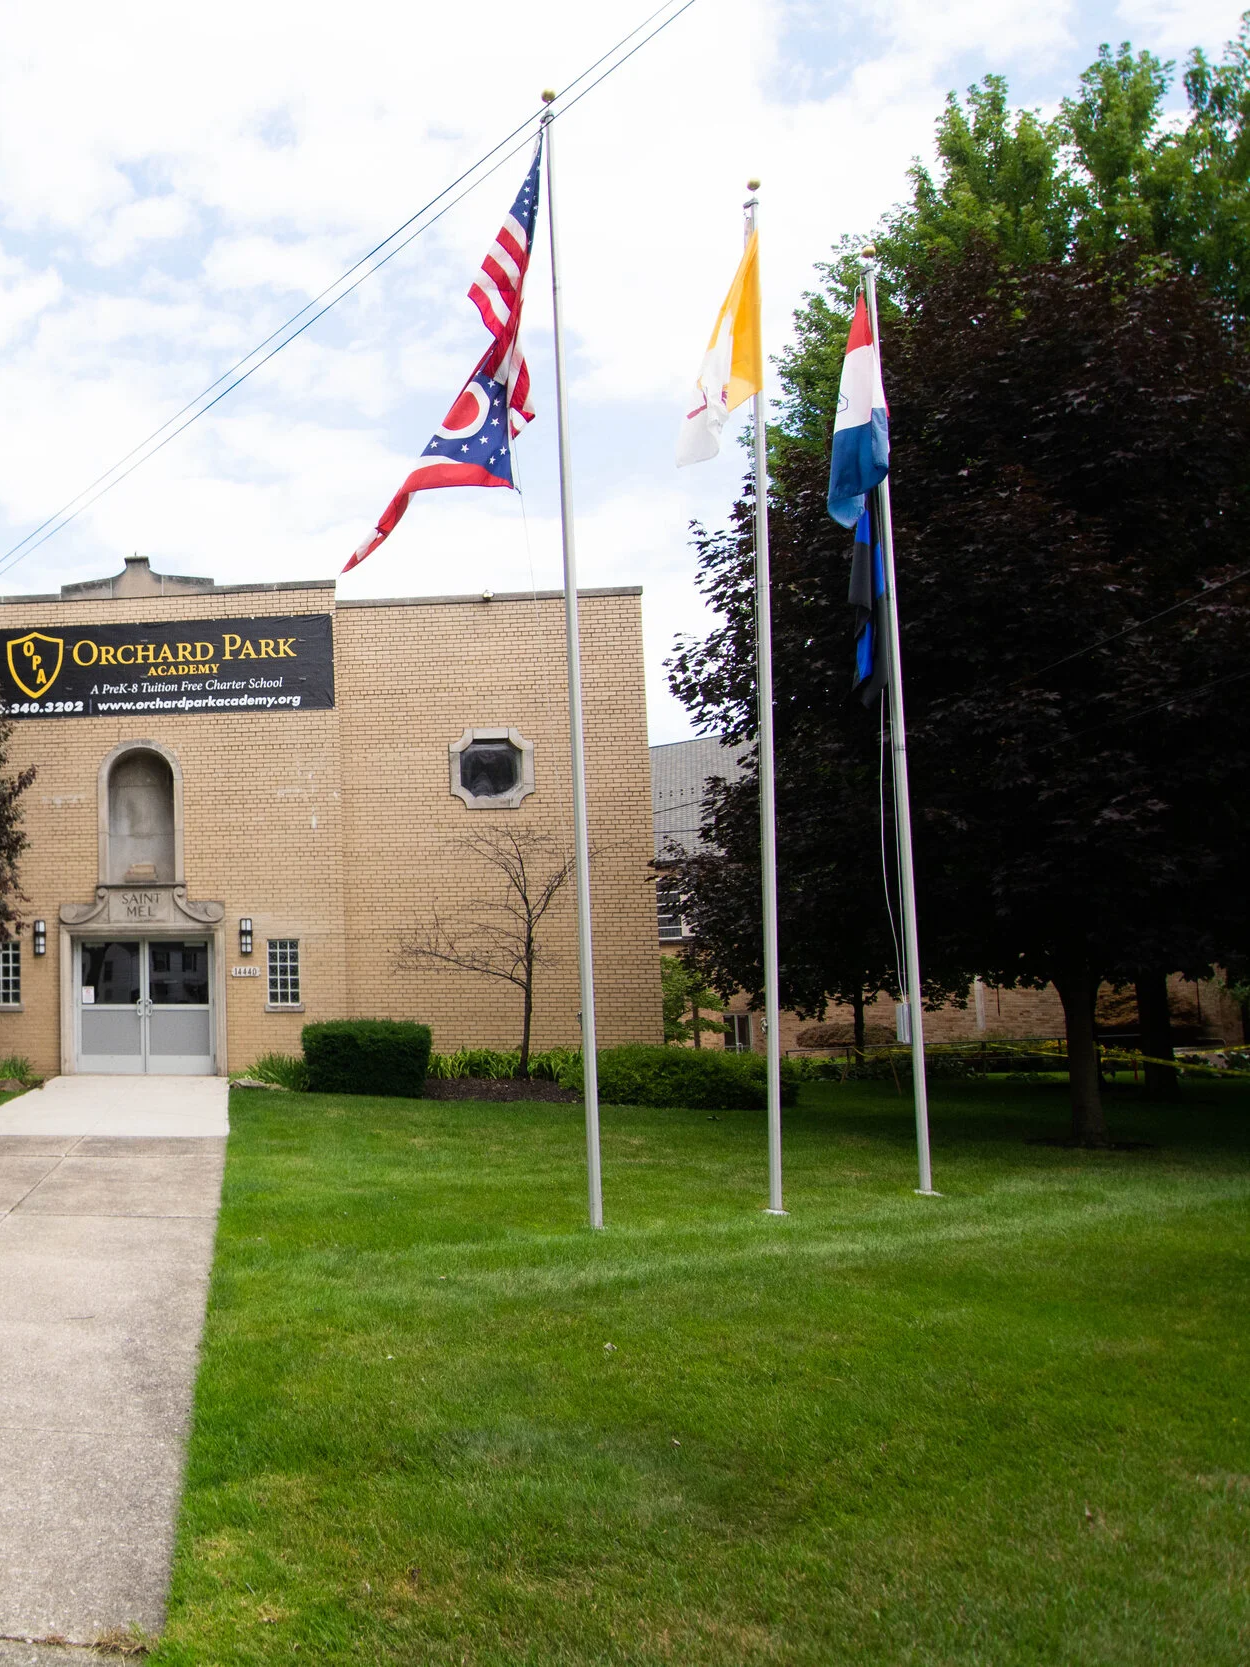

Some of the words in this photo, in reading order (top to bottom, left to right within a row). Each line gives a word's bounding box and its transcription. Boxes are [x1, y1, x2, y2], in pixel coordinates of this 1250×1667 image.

[72, 640, 215, 667] ORCHARD
[222, 633, 297, 660] PARK
[147, 663, 220, 676] ACADEMY
[90, 684, 99, 695] A
[102, 683, 138, 694] PreK-8
[141, 682, 178, 693] Tuition
[181, 680, 203, 692] Free
[205, 679, 247, 691] Charter
[248, 676, 283, 689] School
[97, 694, 301, 711] www.orchardparkacademy.org
[121, 893, 161, 905] SAINT
[127, 905, 157, 917] MEL
[234, 967, 257, 976] 14440
